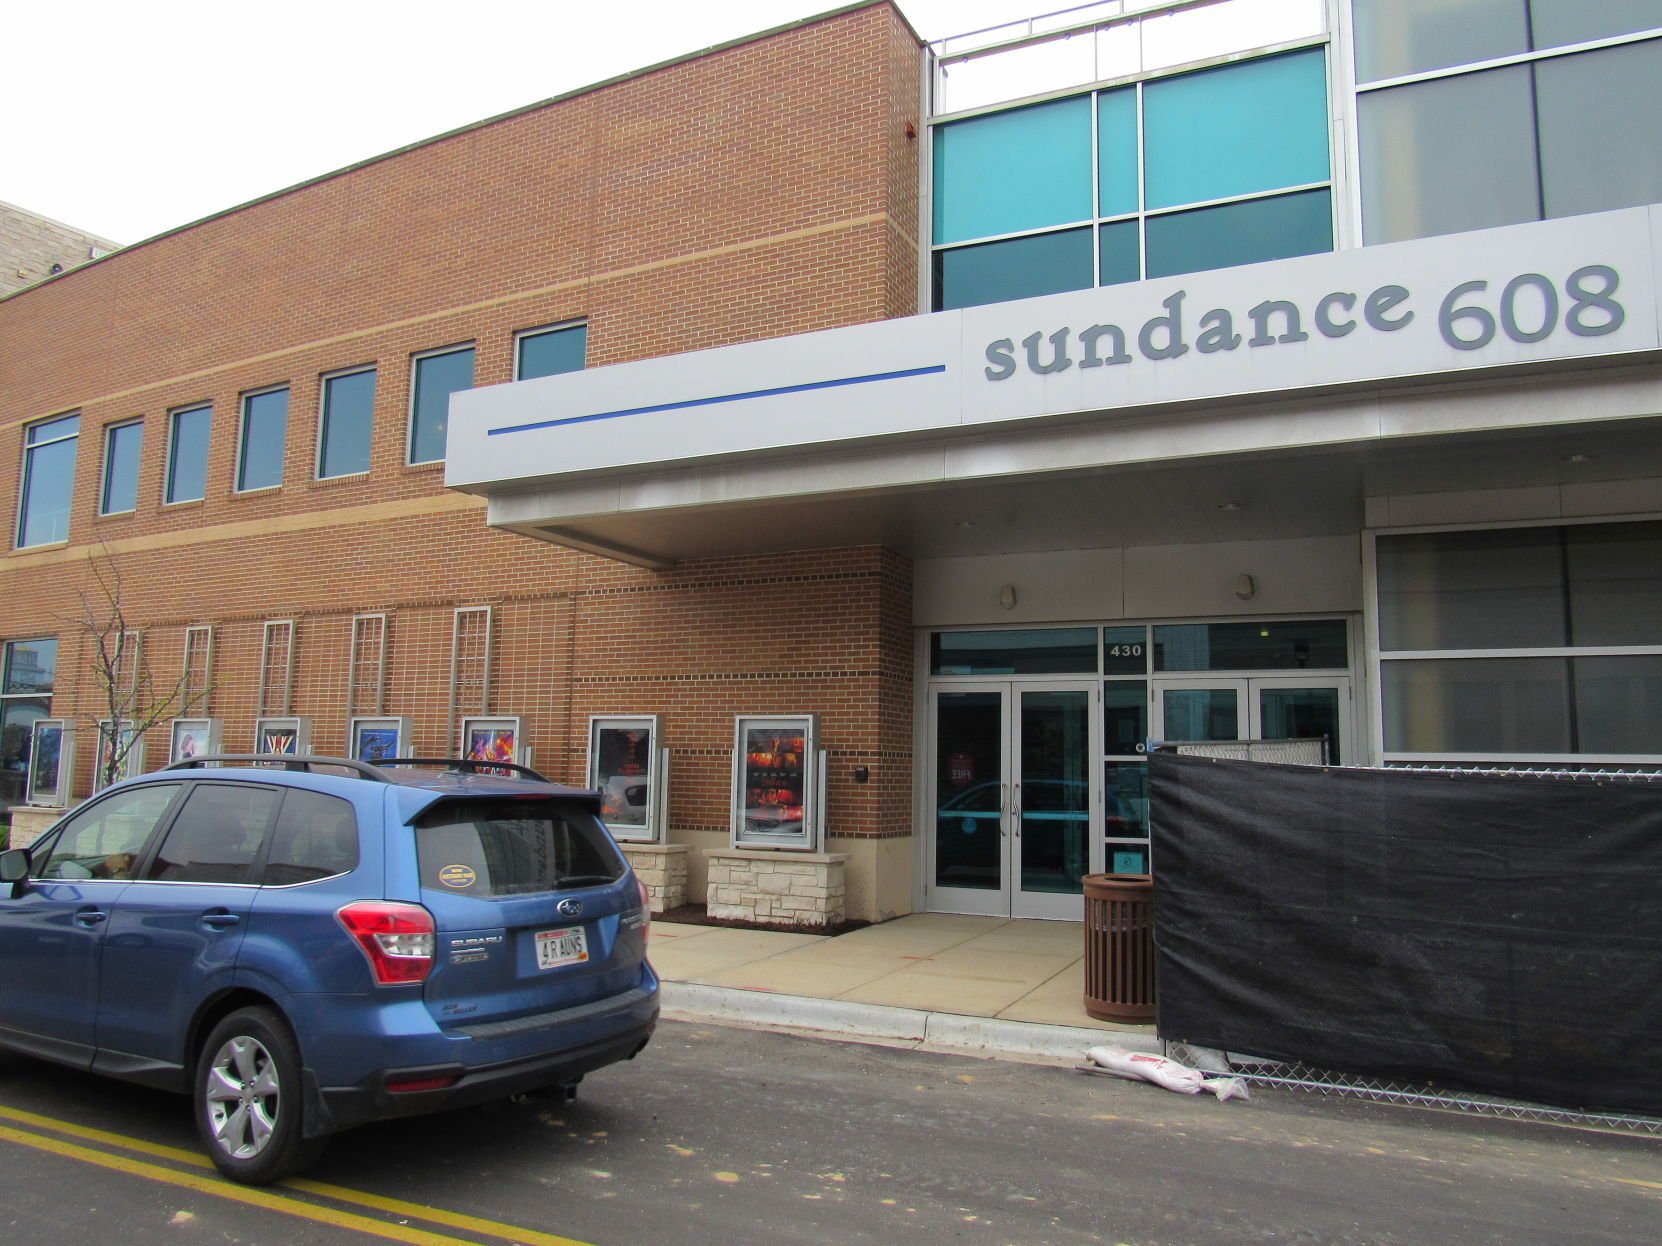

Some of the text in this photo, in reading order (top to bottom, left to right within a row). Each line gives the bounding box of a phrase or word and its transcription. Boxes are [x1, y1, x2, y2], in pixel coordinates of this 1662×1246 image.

[985, 264, 1625, 381] sundance 608
[1110, 644, 1141, 656] 430
[451, 936, 503, 947] SUBARU
